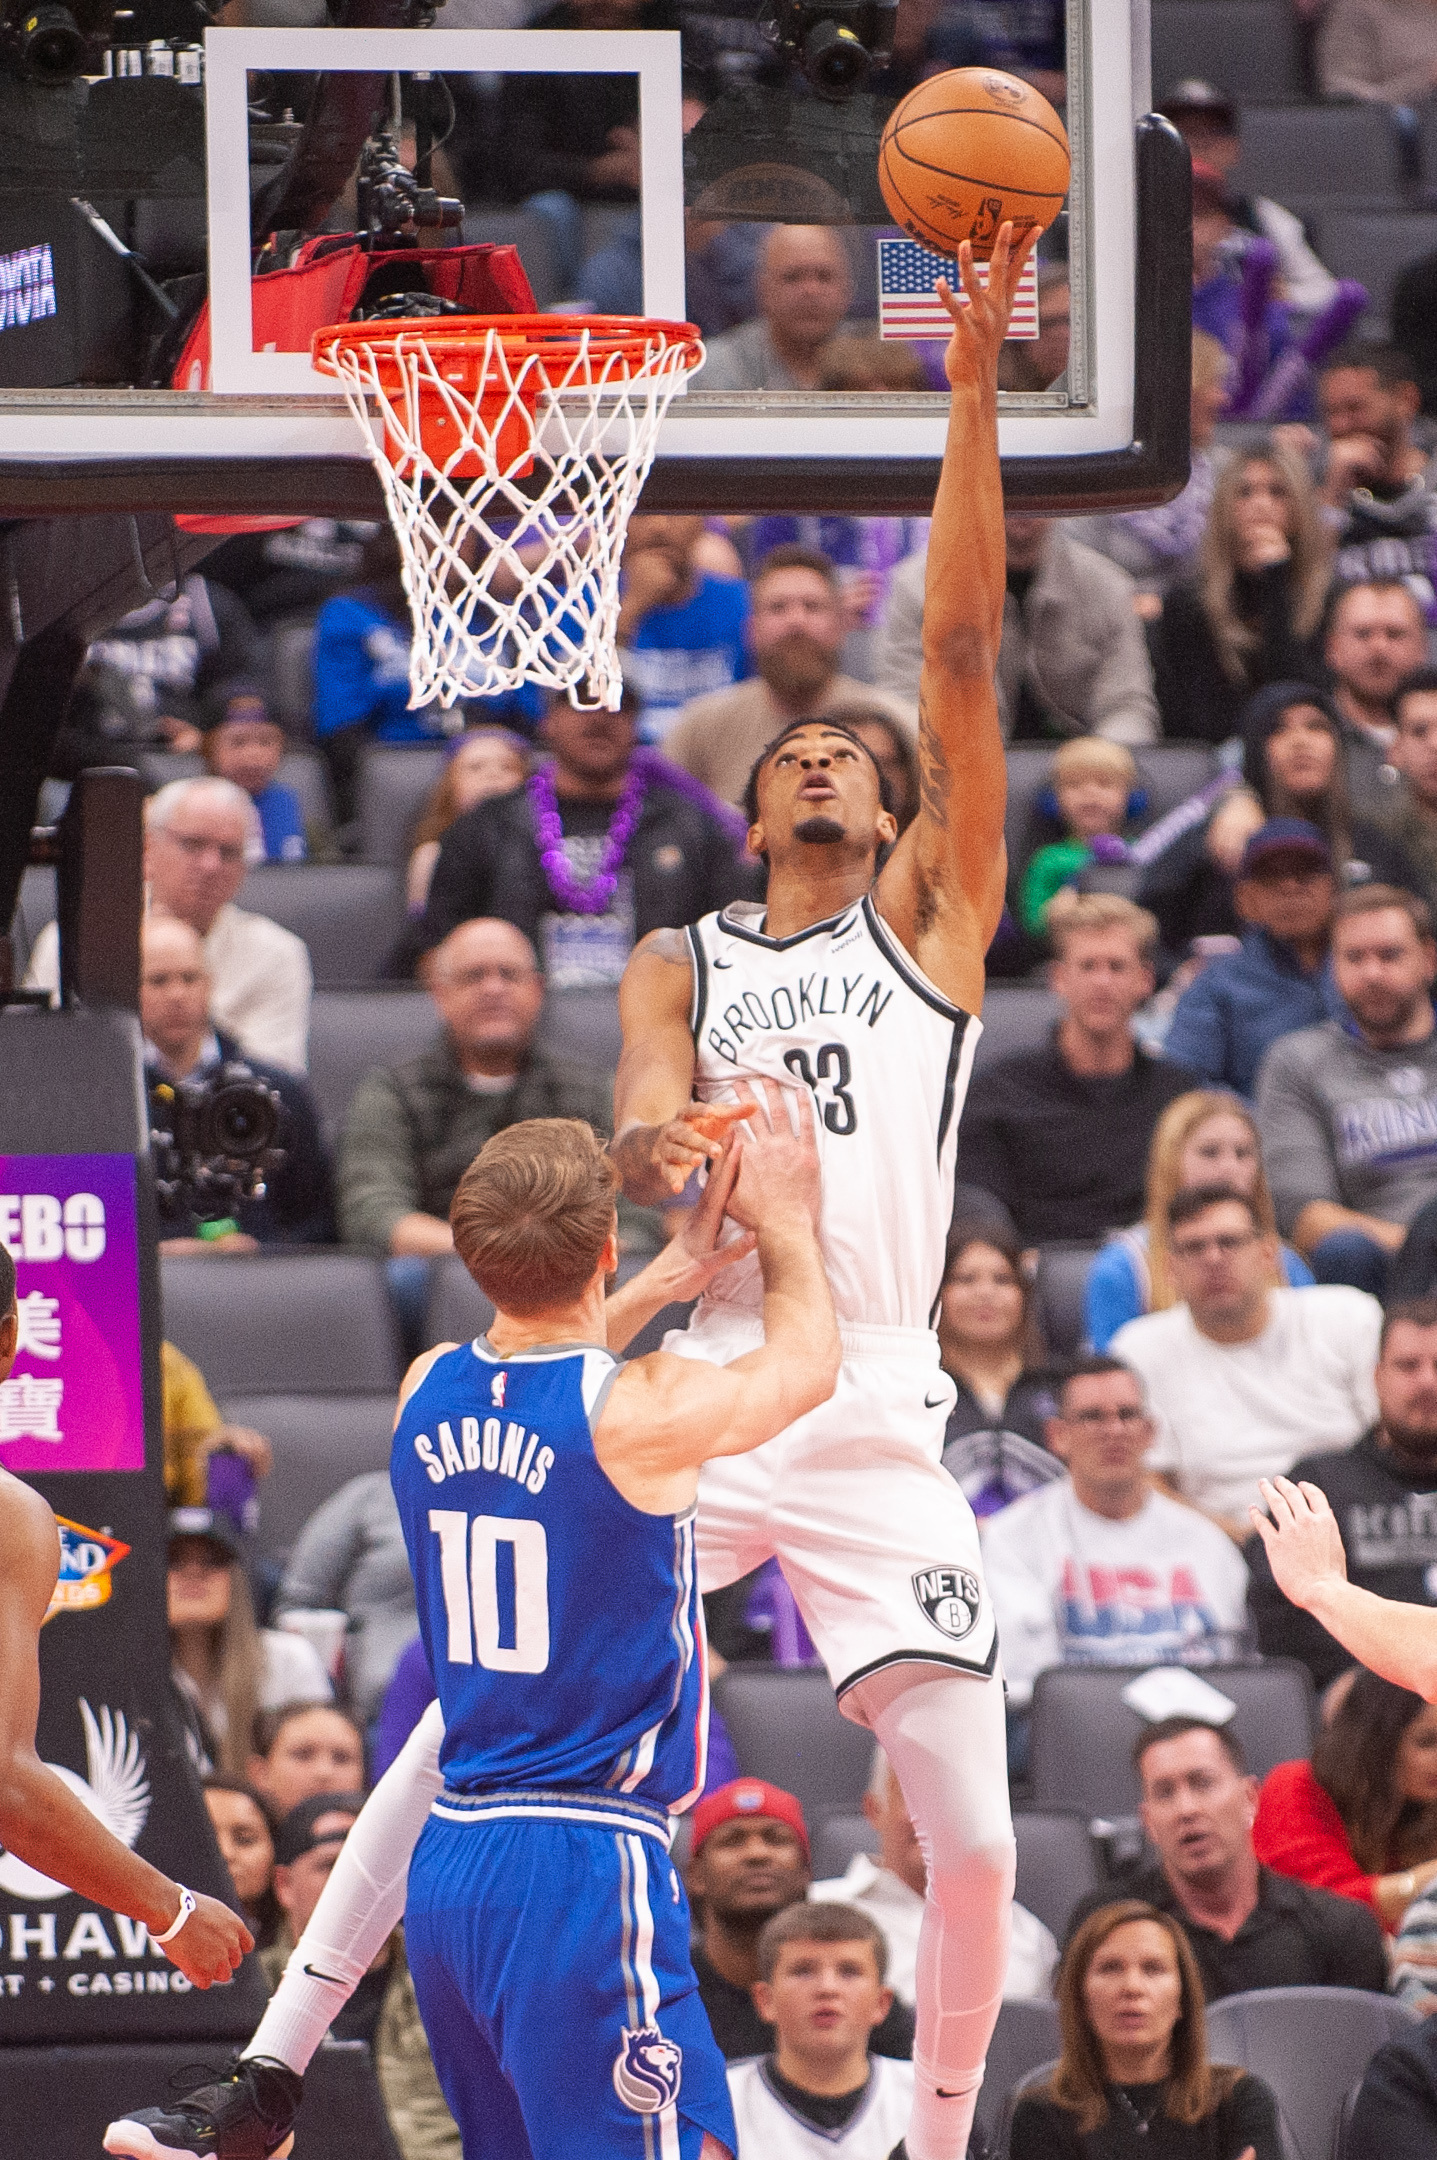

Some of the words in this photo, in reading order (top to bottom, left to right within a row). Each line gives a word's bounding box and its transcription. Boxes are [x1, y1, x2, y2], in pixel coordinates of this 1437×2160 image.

[707, 971, 895, 1066] BROOKLYN
[0, 1193, 107, 1264] EBO
[413, 1416, 556, 1495] SABONIS
[428, 1509, 550, 1674] 10
[917, 1569, 980, 1605] NETS
[949, 1602, 961, 1628] B
[67, 1970, 193, 1997] CASINO
